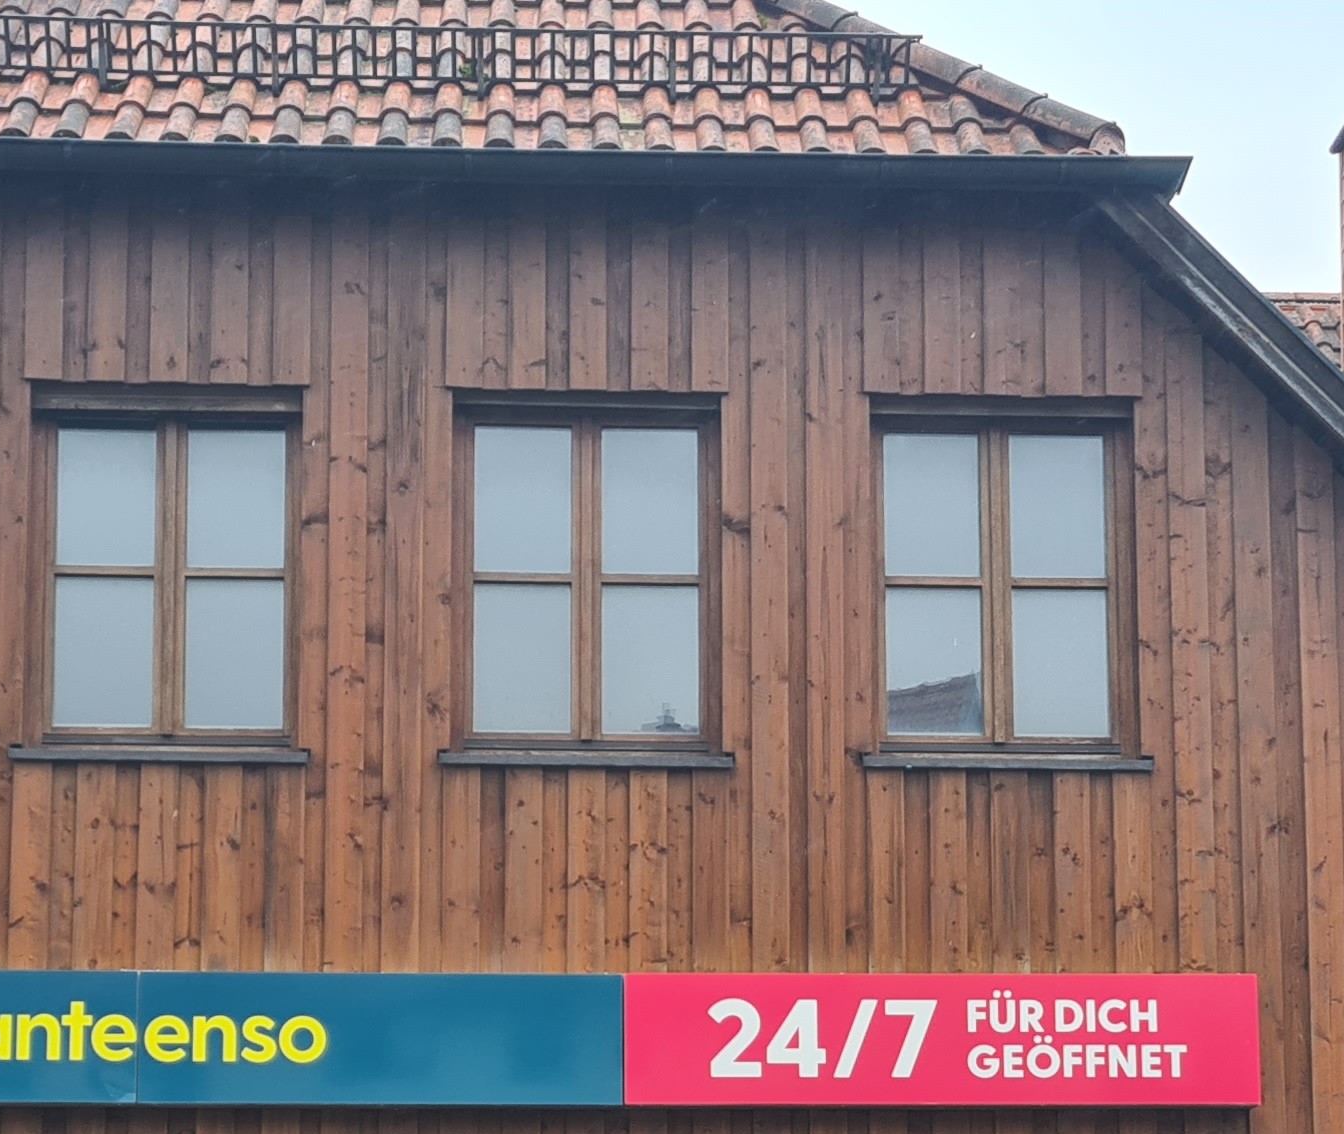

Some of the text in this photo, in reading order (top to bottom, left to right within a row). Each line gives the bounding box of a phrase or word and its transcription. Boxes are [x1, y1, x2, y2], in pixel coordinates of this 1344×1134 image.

[967, 989, 1158, 1033] FÜR DICH
[707, 997, 938, 1079] 24/7
[967, 1034, 1188, 1079] GEÖFFNET
